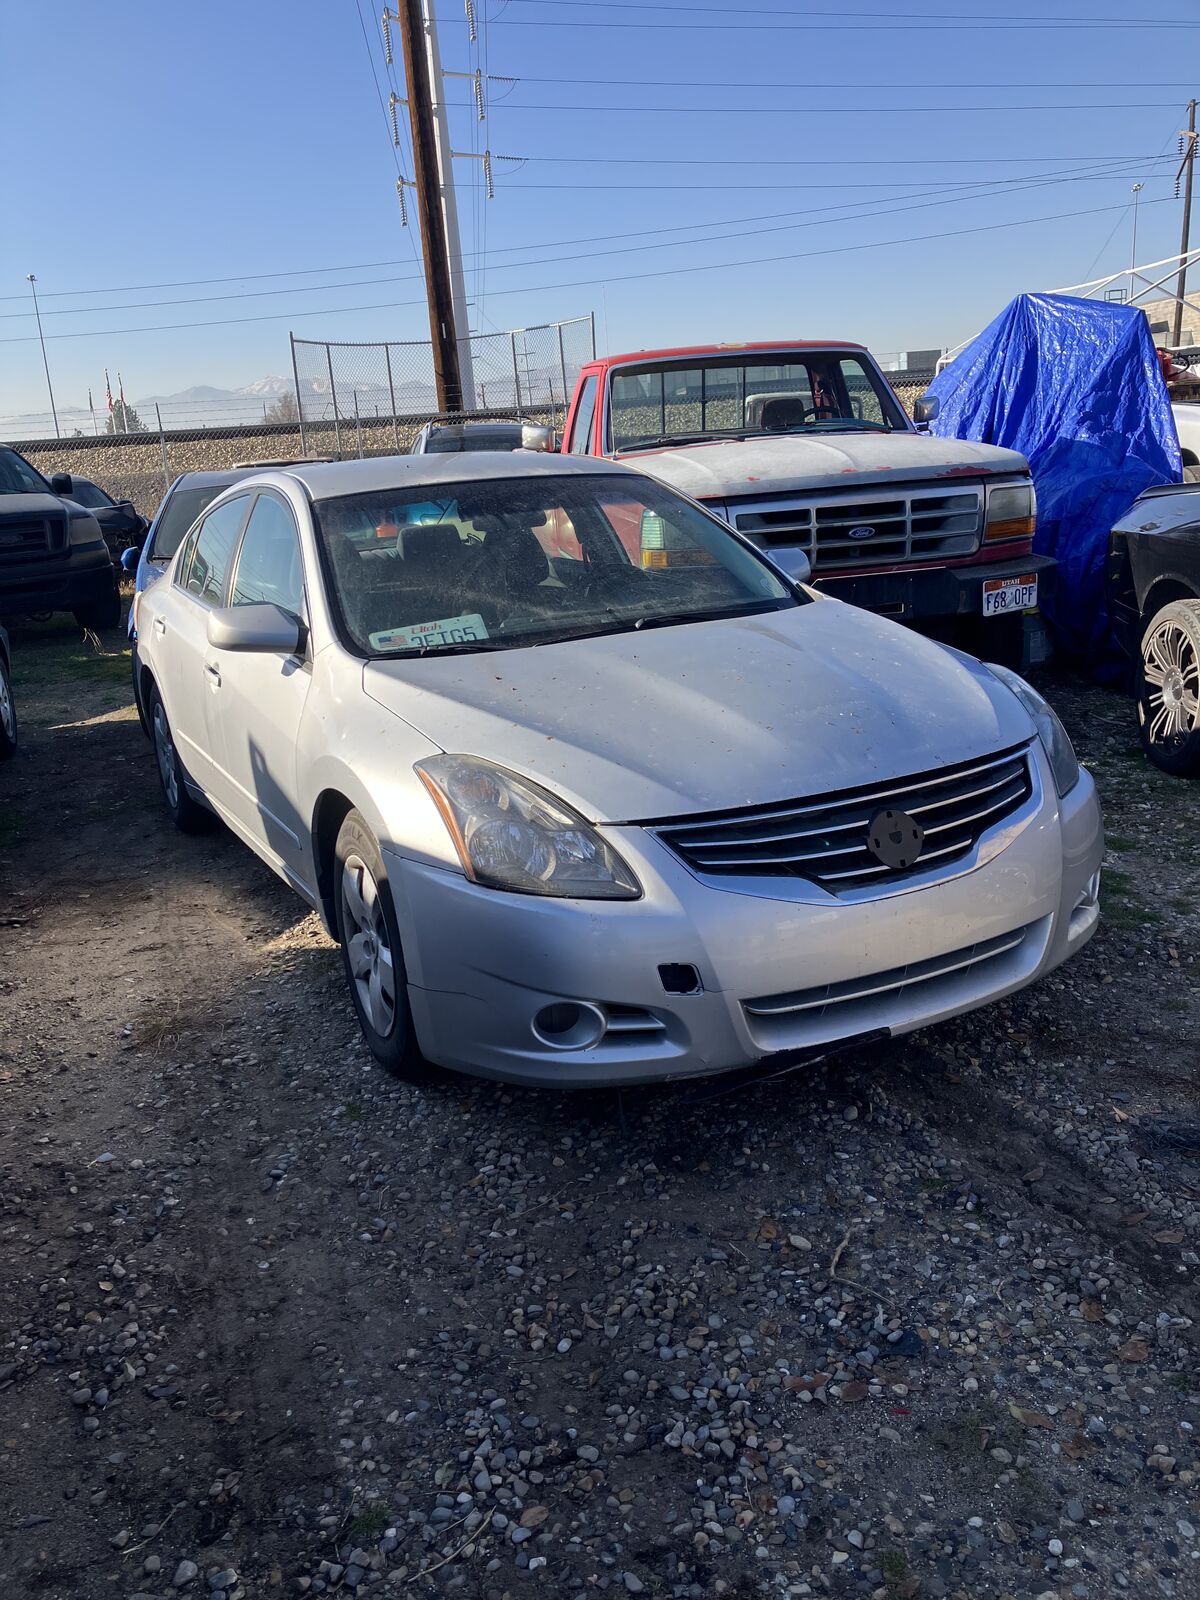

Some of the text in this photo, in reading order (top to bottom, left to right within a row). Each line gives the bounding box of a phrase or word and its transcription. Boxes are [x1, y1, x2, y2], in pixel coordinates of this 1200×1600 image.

[1001, 578, 1020, 587] UTAH
[986, 591, 1006, 611] F68
[411, 623, 442, 635] Utah
